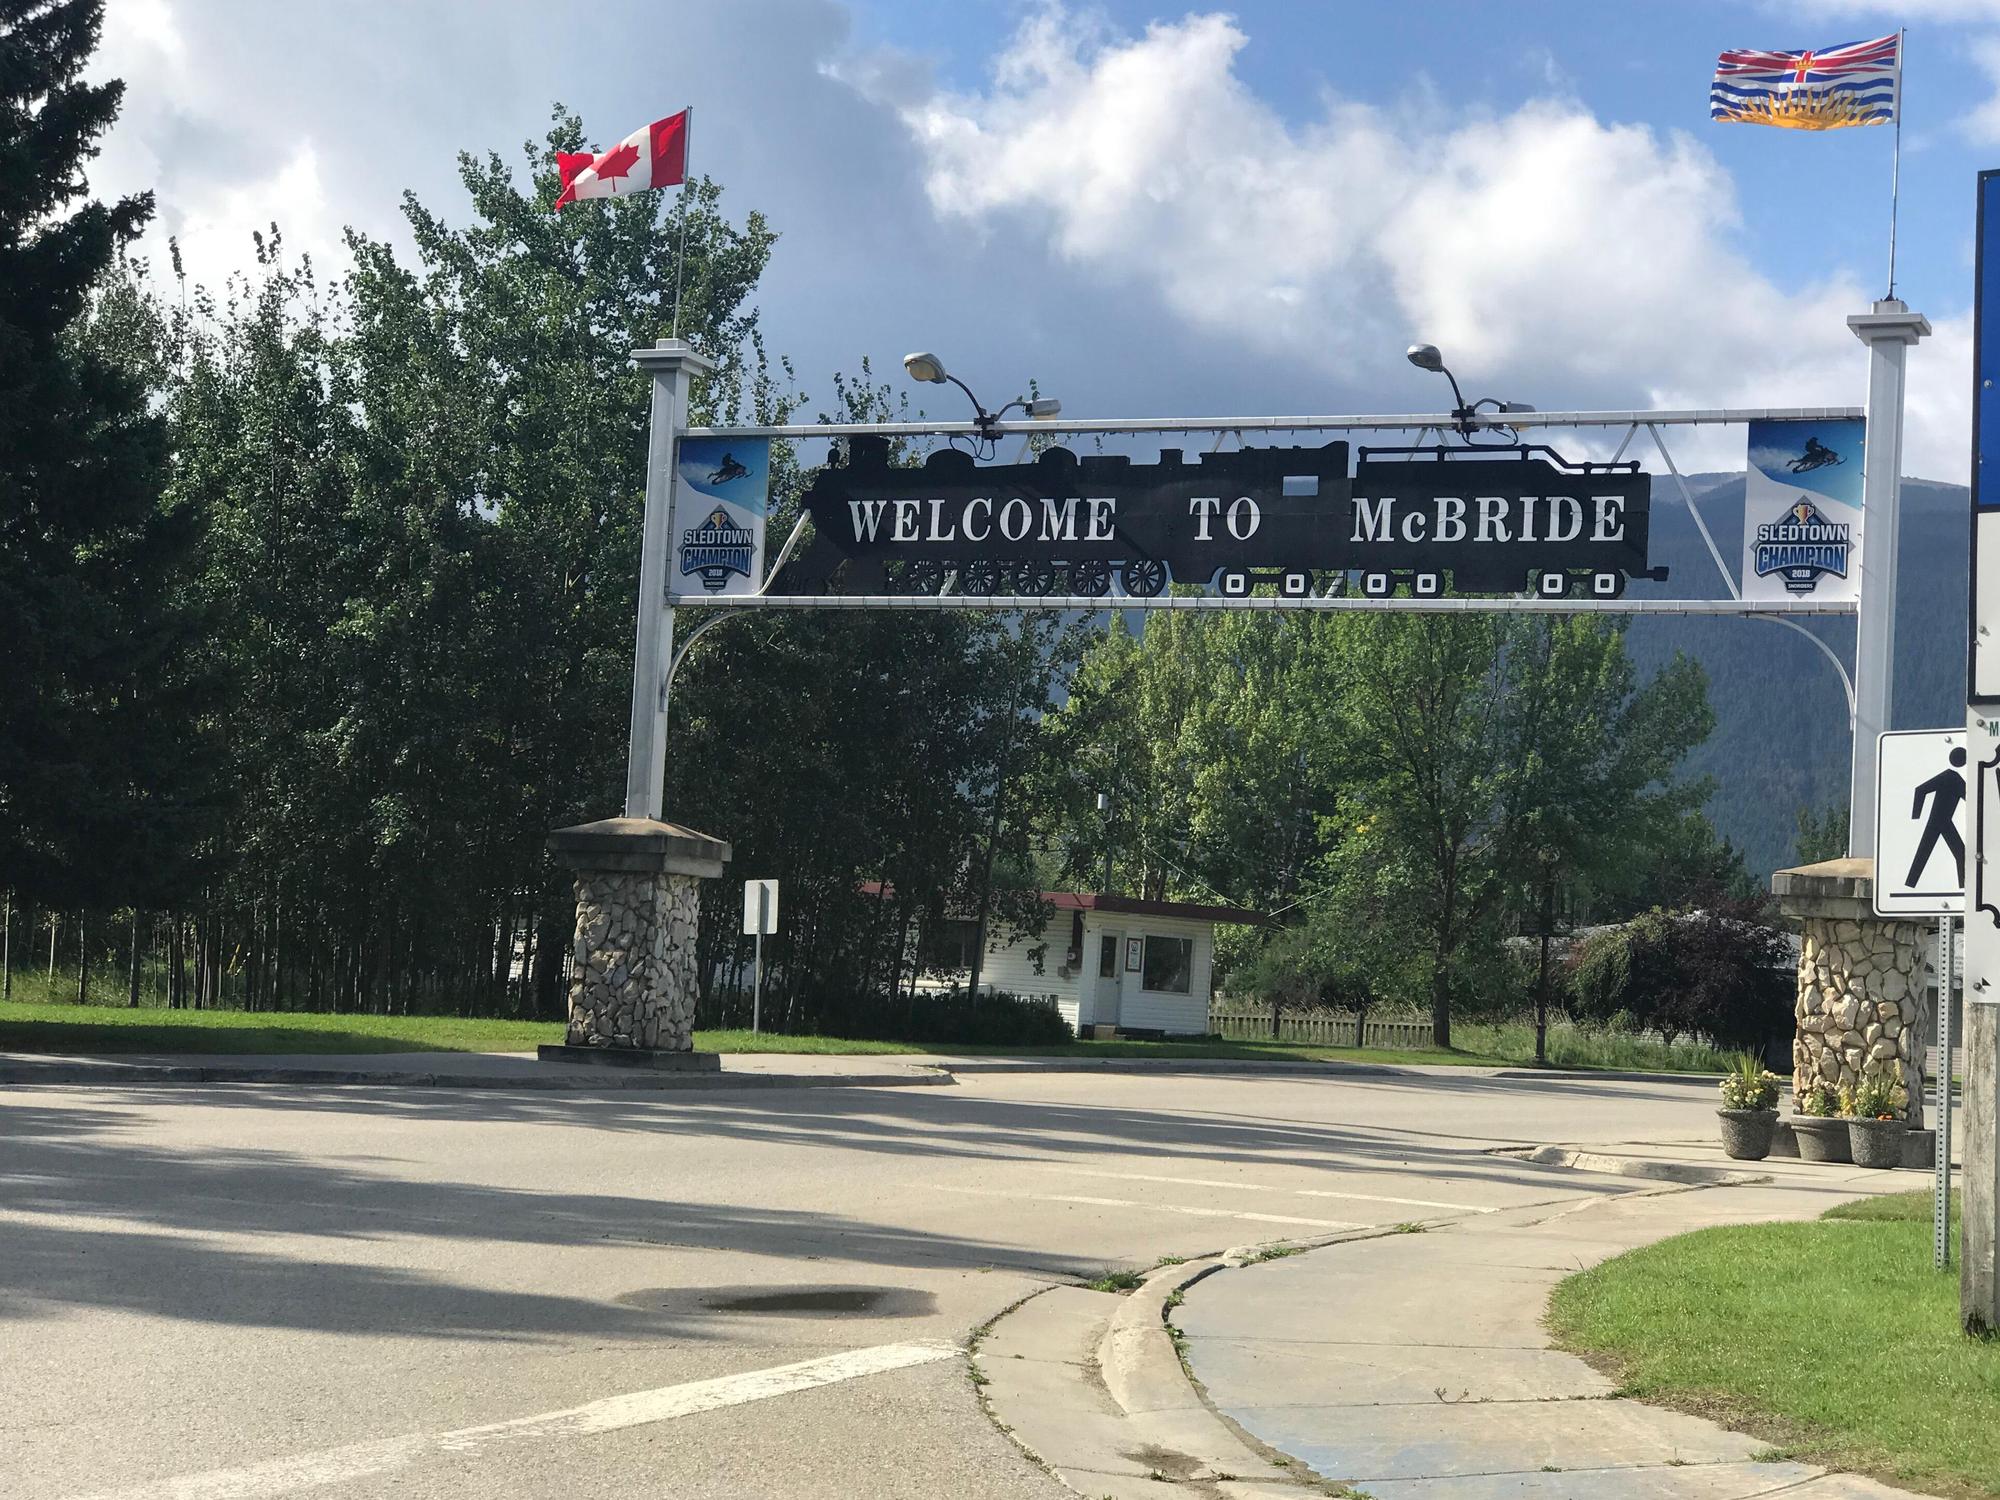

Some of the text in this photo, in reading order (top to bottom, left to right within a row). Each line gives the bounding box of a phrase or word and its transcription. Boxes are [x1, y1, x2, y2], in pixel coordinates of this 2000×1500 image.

[847, 495, 1625, 543] WELCOME TO McBRIDE
[684, 529, 752, 545] SLEDTOWN
[1758, 524, 1848, 541] SLEDTOWN
[683, 547, 750, 573] CHAMPION
[1757, 545, 1846, 573] CHAMPION
